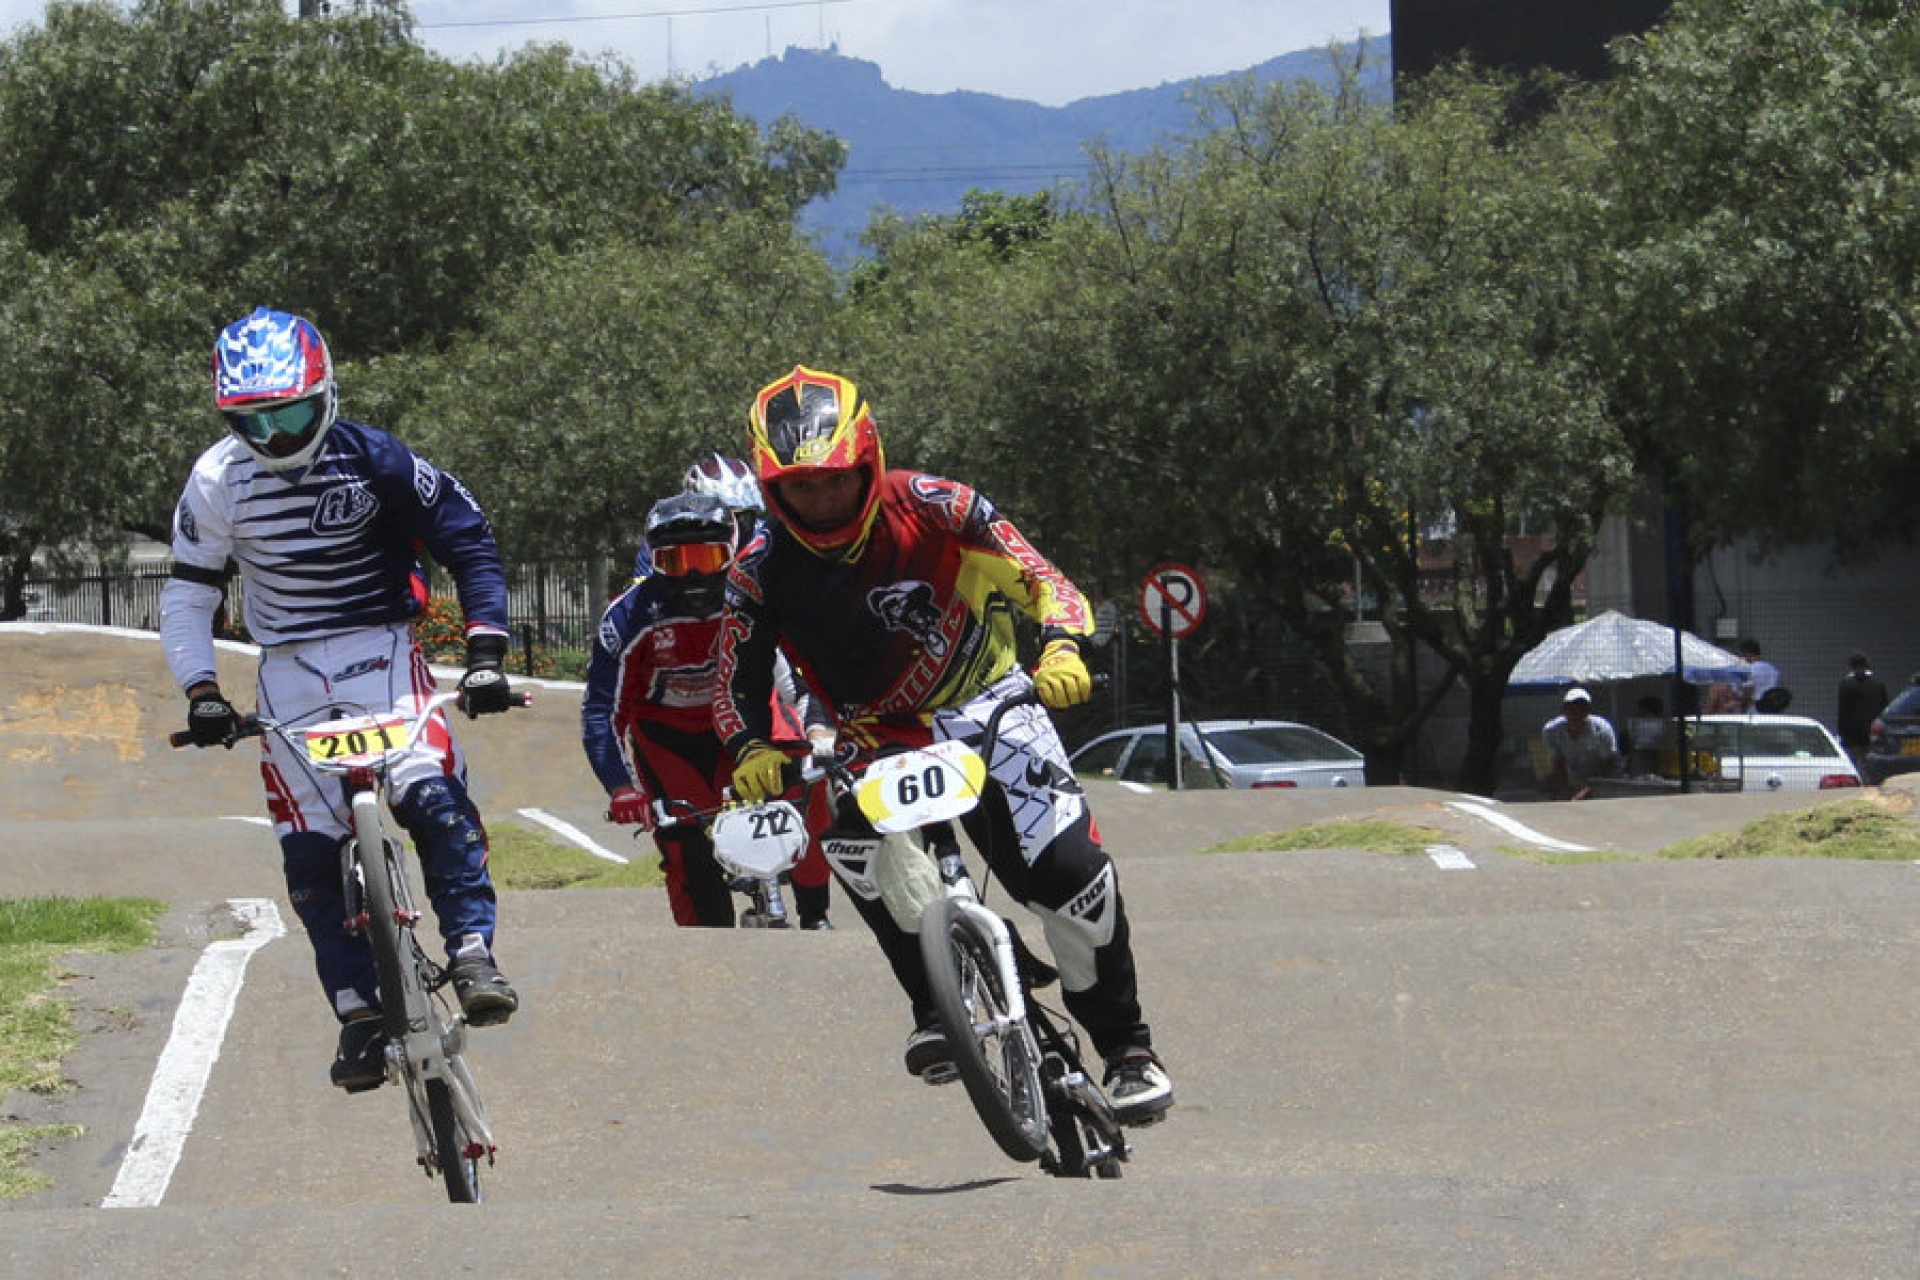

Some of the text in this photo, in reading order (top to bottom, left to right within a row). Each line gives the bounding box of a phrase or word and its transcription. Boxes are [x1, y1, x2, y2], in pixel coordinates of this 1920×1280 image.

[318, 727, 393, 758] 201
[898, 766, 945, 805] 60
[748, 809, 793, 839] 212
